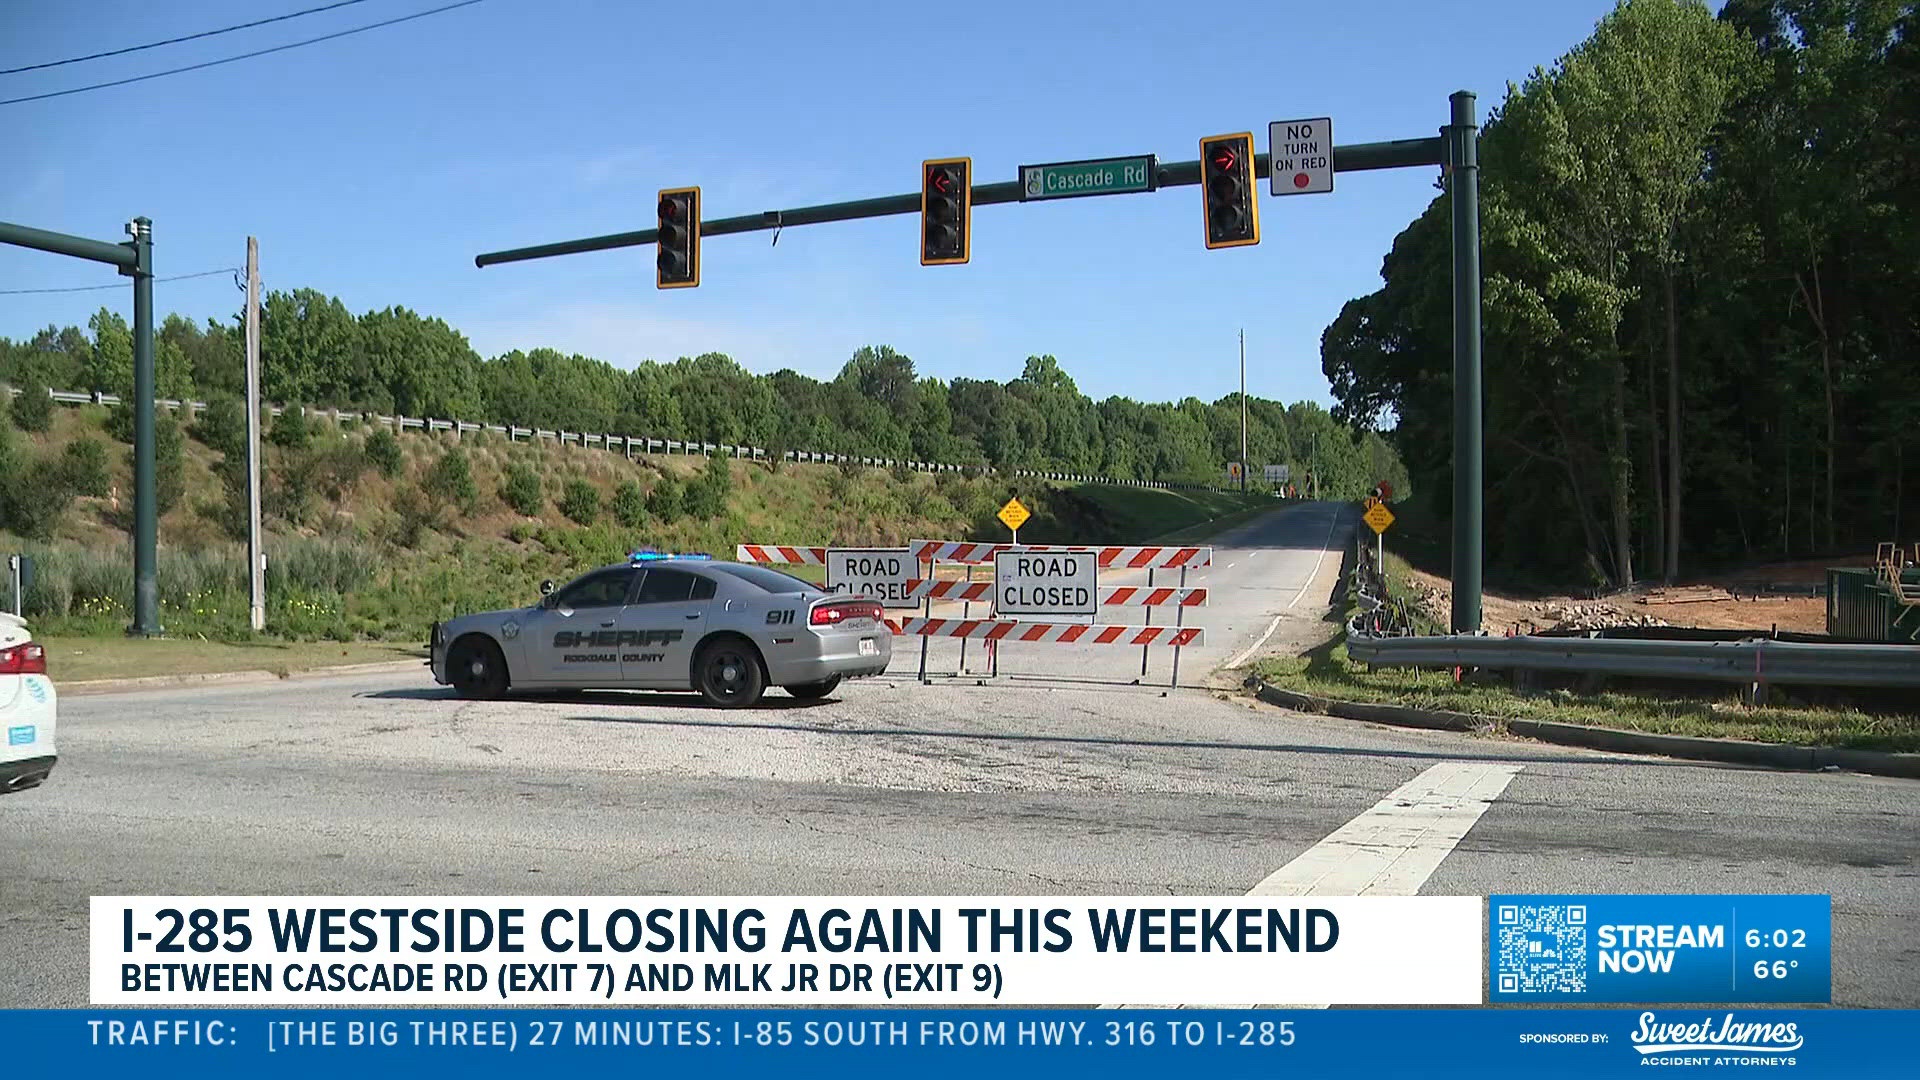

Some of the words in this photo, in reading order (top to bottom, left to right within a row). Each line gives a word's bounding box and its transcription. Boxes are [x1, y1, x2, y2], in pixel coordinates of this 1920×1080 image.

[1287, 125, 1312, 140] NO
[1284, 142, 1317, 156] TURN
[1275, 159, 1293, 171] ON
[1301, 157, 1327, 169] RED
[1047, 169, 1114, 191] Cascade
[1124, 164, 1145, 184] Rd
[846, 558, 901, 577] ROAD
[1018, 558, 1077, 577] ROAD
[1004, 587, 1089, 606] CLOSED
[766, 610, 796, 624] 911
[553, 629, 684, 648] SHERIFF
[563, 654, 617, 663] ROCKDALE
[622, 653, 665, 663] COUNTY
